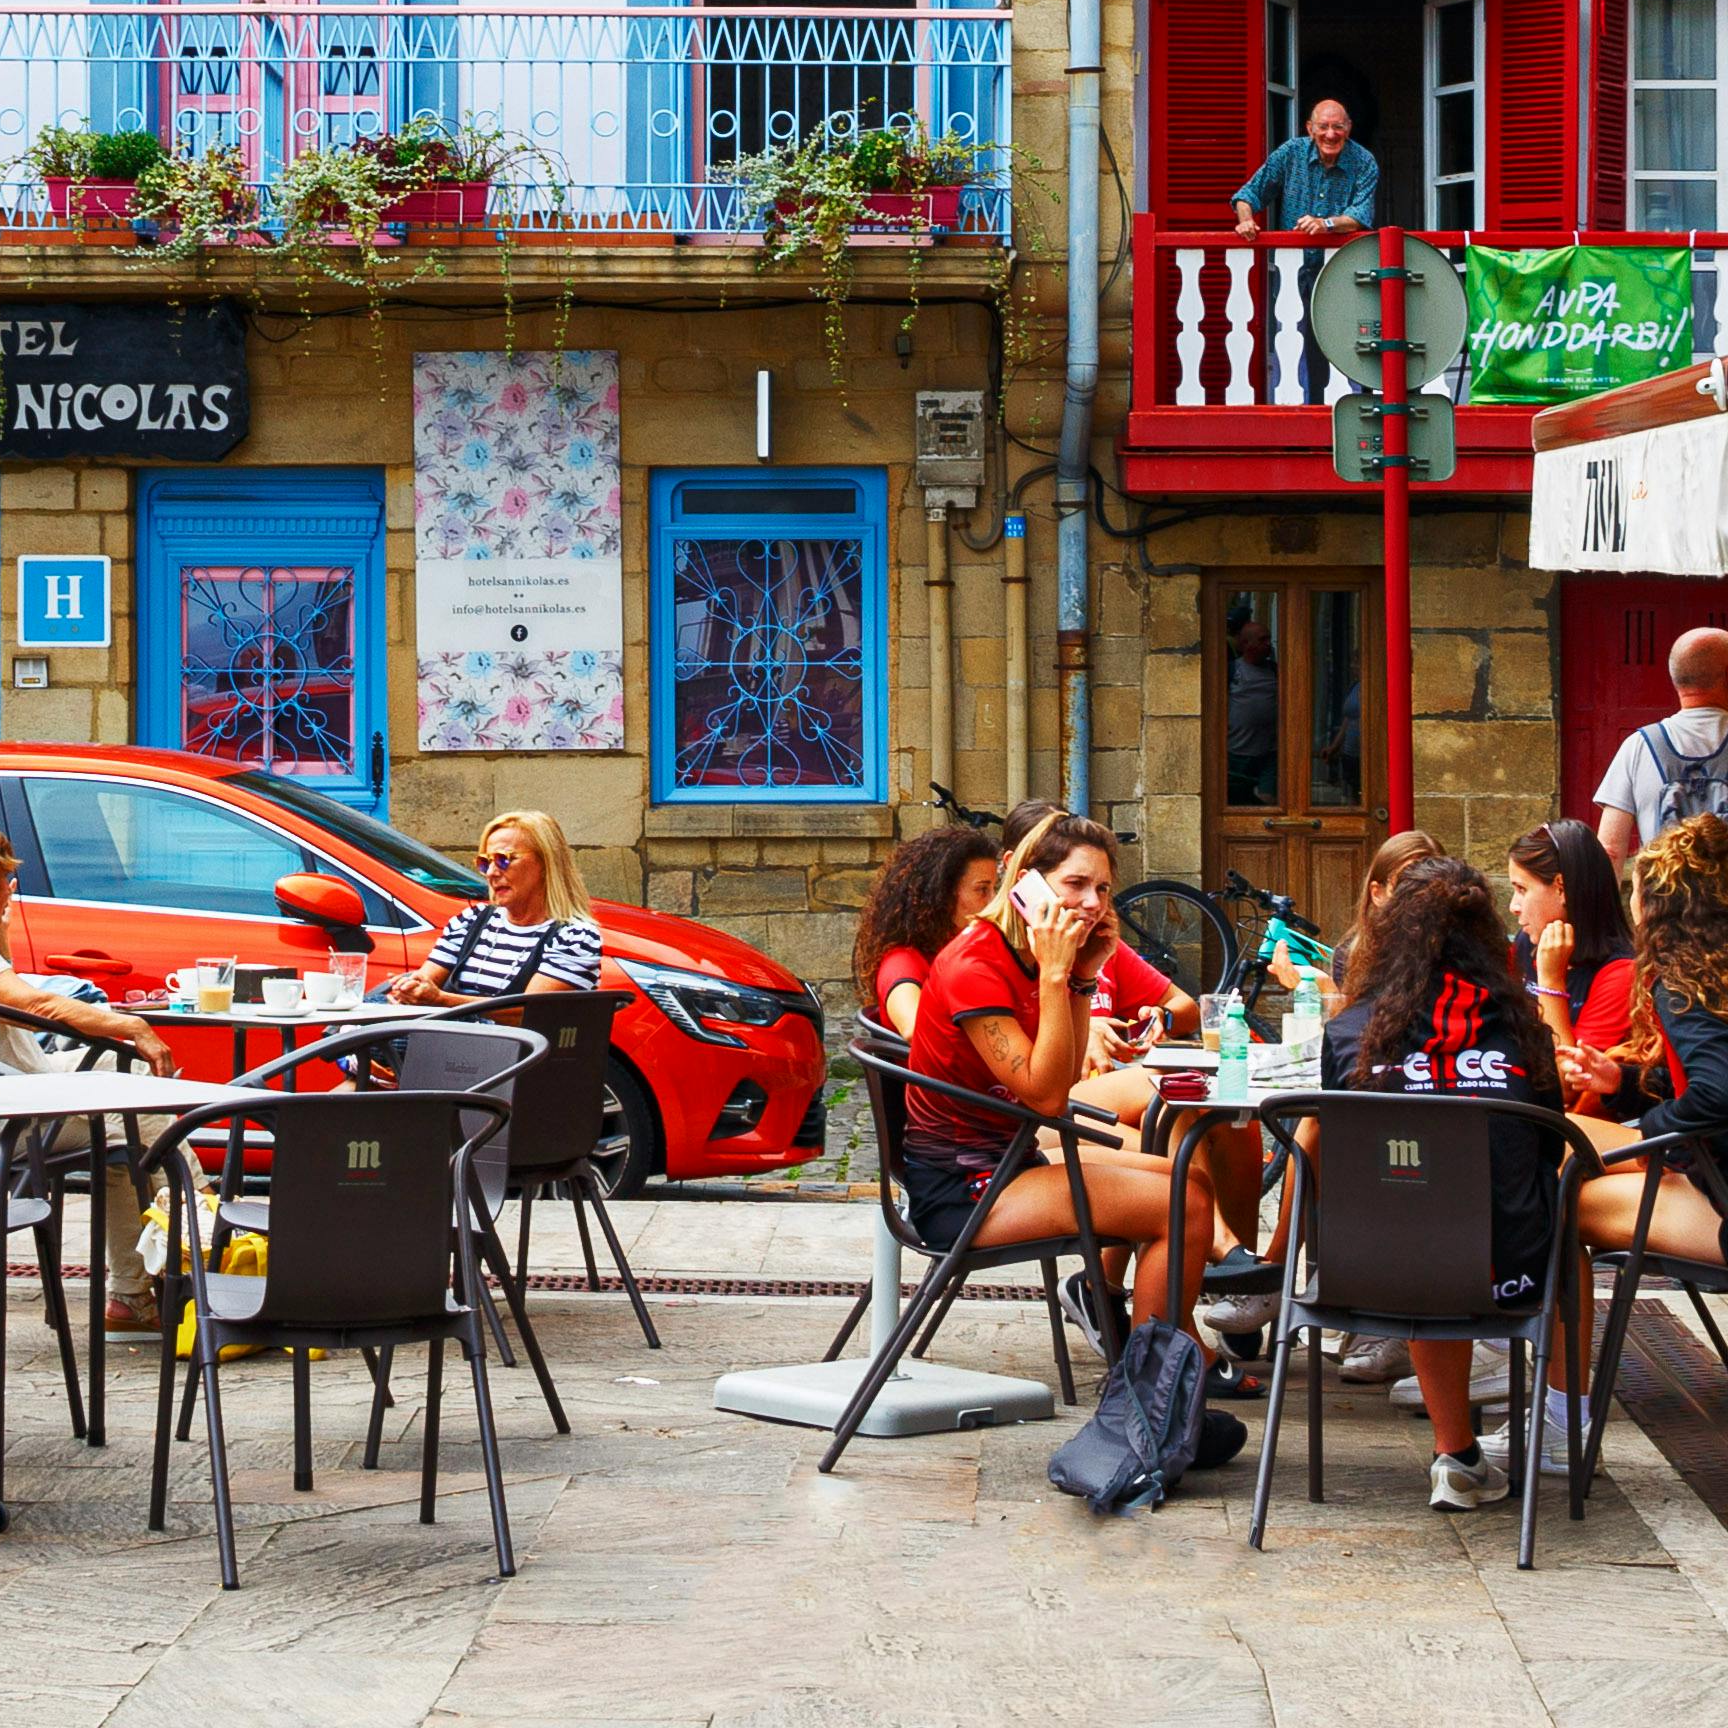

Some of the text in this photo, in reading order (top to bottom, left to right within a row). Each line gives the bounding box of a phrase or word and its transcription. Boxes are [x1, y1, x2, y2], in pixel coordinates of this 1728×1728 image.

[468, 576, 569, 587] hotelsannikolas.es
[44, 575, 84, 619] H
[452, 603, 586, 615] info@hotelsannikolas.es
